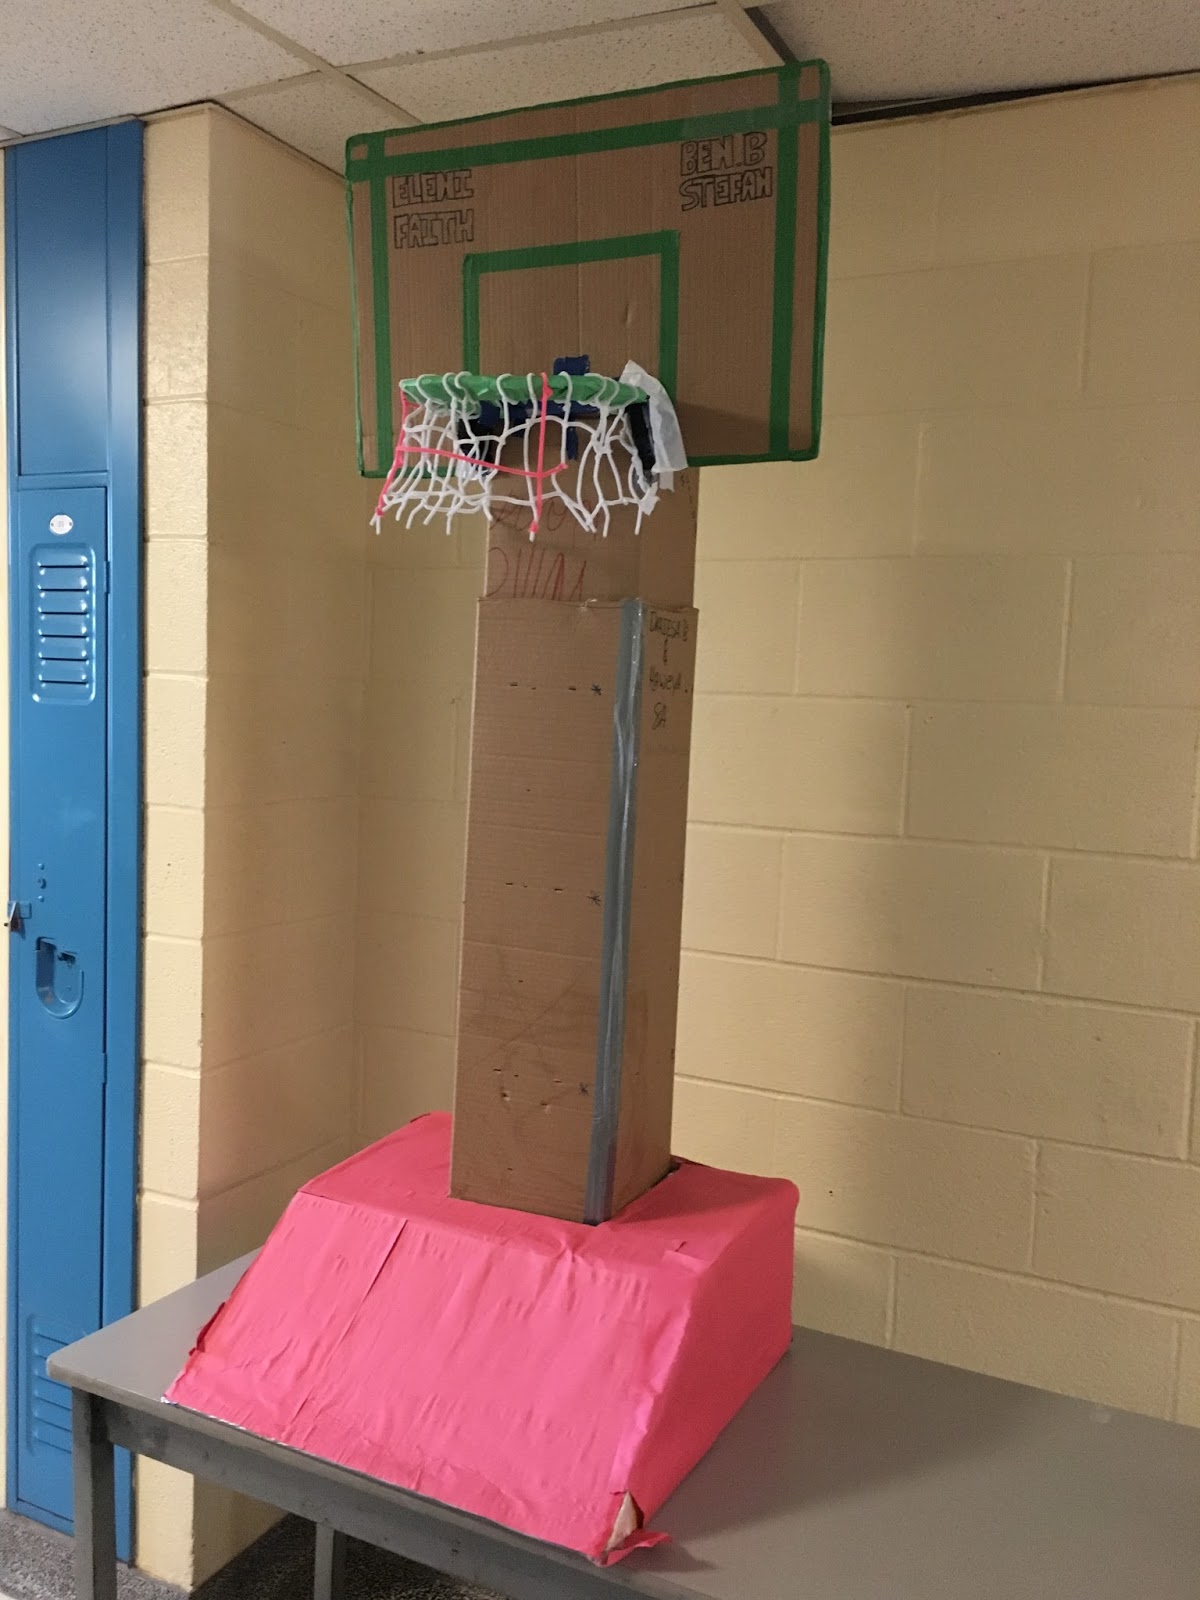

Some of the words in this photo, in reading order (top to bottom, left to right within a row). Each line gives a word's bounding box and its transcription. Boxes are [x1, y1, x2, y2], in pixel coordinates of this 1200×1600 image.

[681, 131, 768, 176] BEN.B
[392, 168, 474, 209] ELENI
[679, 166, 773, 212] STEFAN
[393, 208, 475, 249] FAITH
